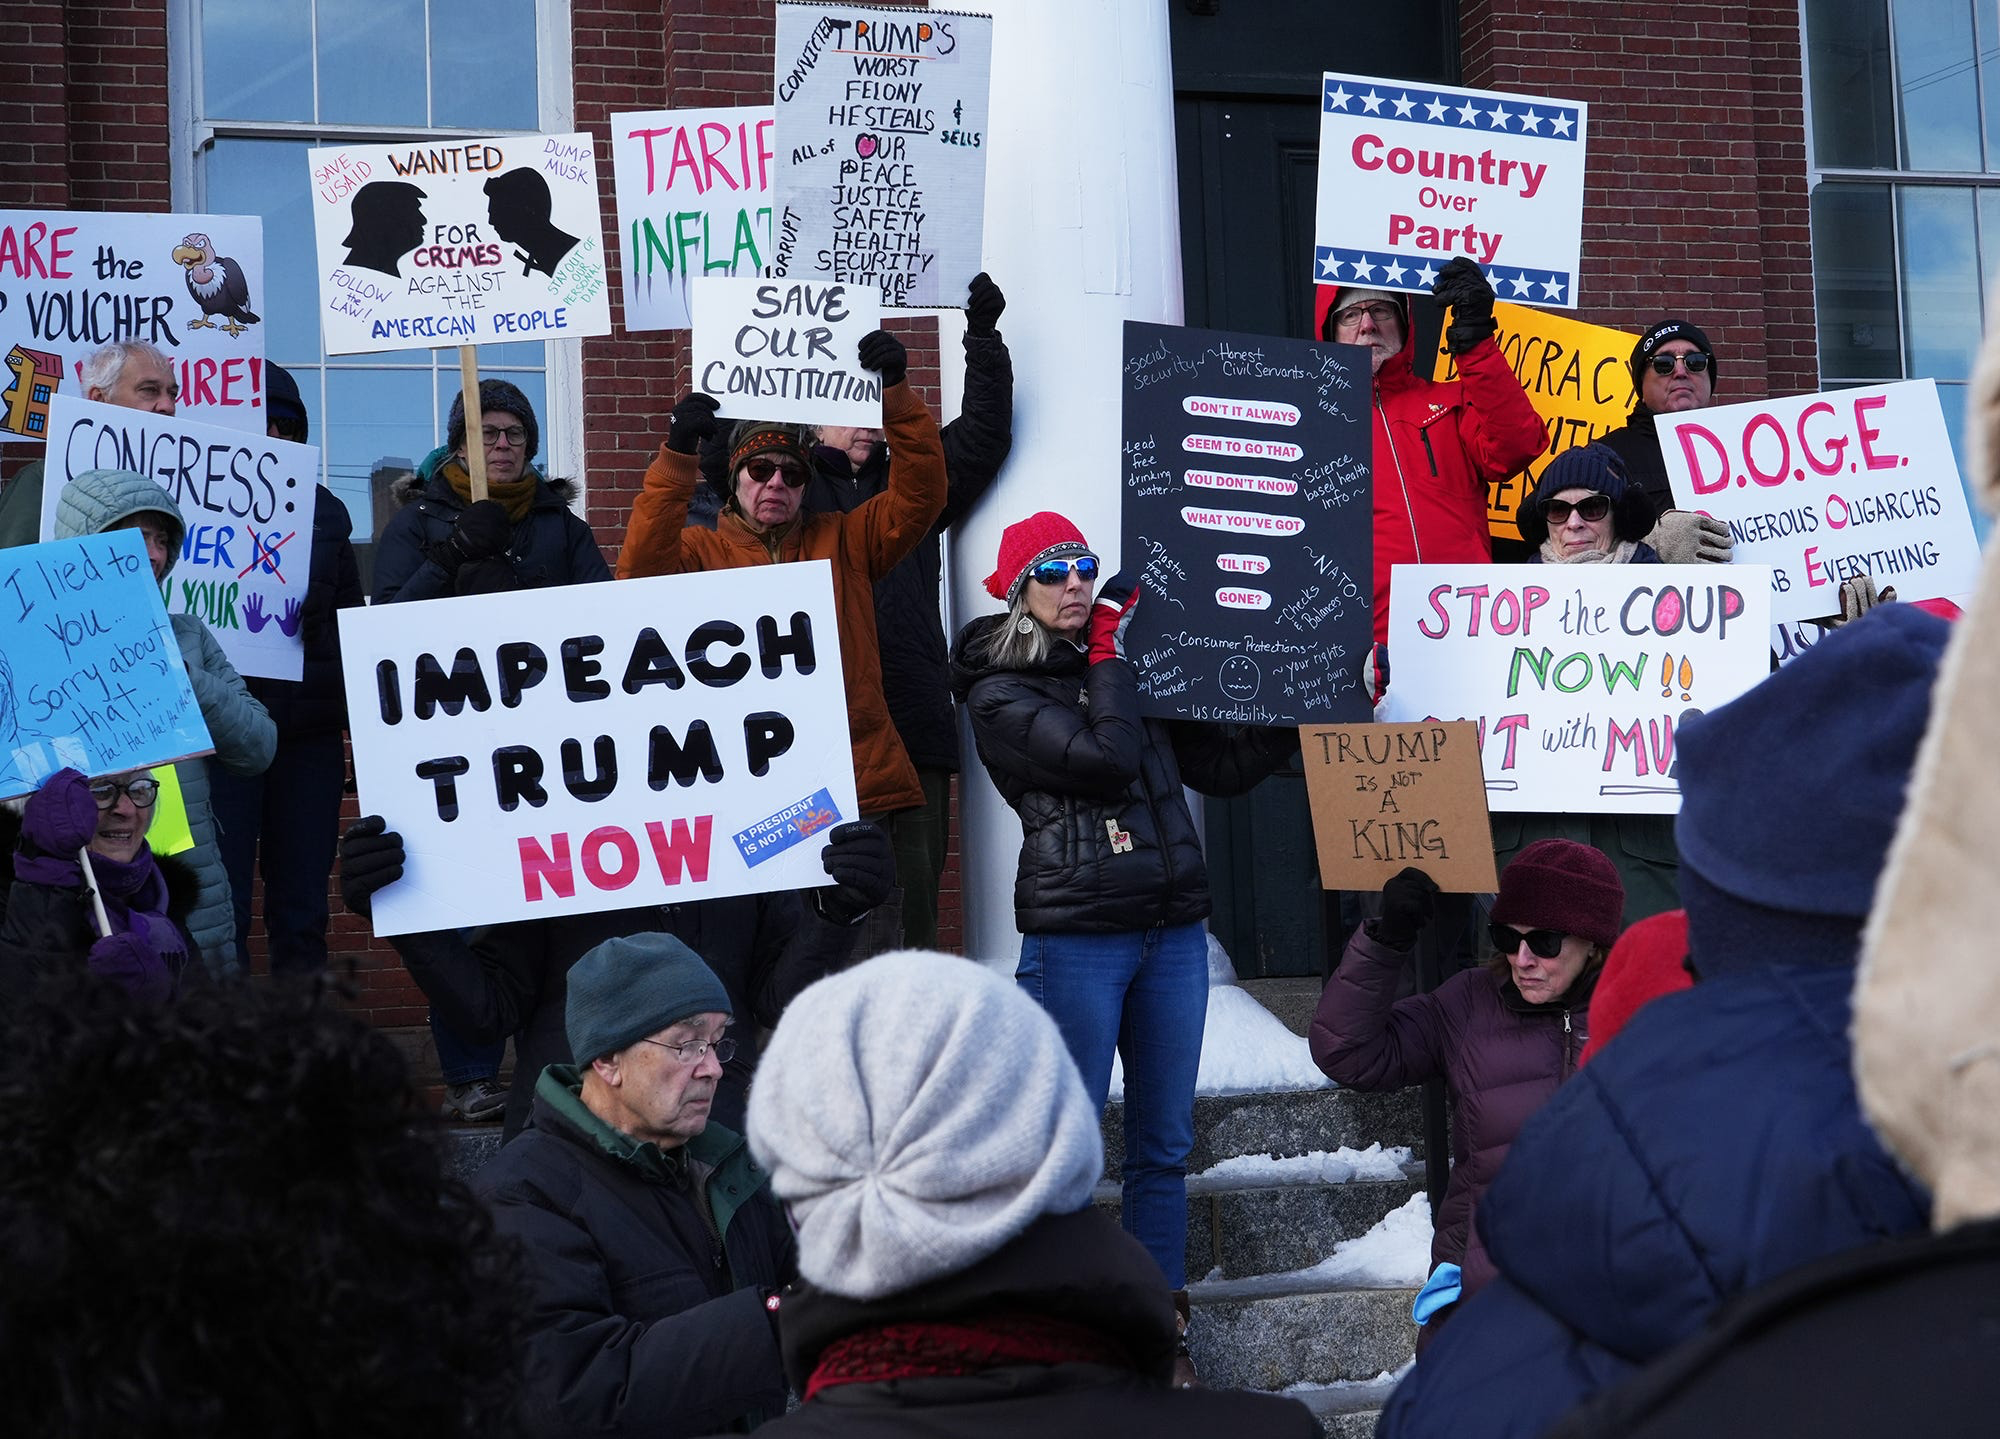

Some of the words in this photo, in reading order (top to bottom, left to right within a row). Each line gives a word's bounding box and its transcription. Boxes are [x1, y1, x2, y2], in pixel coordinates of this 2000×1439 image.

[831, 20, 956, 55] TRUMP'S
[854, 56, 919, 77] WORST
[846, 81, 922, 101] FELONY
[543, 138, 592, 162] DUMP
[855, 133, 905, 160] OUR
[940, 130, 981, 147] SELLS
[314, 153, 352, 185] SAVE
[387, 144, 504, 176] WANTED
[544, 159, 589, 185] MUSK
[839, 159, 916, 187] PEACE
[1351, 133, 1548, 198] Country
[320, 160, 372, 205] USAID
[830, 185, 923, 210] JUSTICE
[1419, 187, 1478, 213] Over
[435, 224, 481, 245] FOR
[833, 207, 926, 231] SAFETY
[833, 231, 920, 253] HEALTH
[1388, 214, 1503, 264] Party
[92, 245, 144, 281] the
[413, 243, 502, 269] CRIMES
[547, 269, 568, 296] STAY
[564, 249, 585, 273] OUT
[583, 236, 596, 252] OF
[571, 262, 590, 282] OUR
[814, 250, 934, 272] SECURITY
[329, 268, 393, 303] FOLLOW
[408, 270, 506, 296] AGAINST
[562, 263, 603, 306] PERSONAL
[580, 278, 605, 304] DATA
[26, 288, 181, 347] VOUCHER
[442, 293, 486, 310] THE
[751, 284, 850, 323] SAVE
[371, 315, 476, 339] AMERICAN
[494, 307, 568, 334] PEOPLE
[735, 324, 837, 361] OUR
[701, 360, 881, 403] CONSTITUTION
[1190, 400, 1228, 416] DON'T
[1232, 405, 1243, 417] IT
[1245, 407, 1297, 423] ALWAYS
[1186, 437, 1222, 451] SEEM
[1225, 441, 1241, 453] TO
[1245, 443, 1263, 455] GO
[1266, 445, 1297, 458] THAT
[1674, 395, 1909, 494] D.O.G.E.
[65, 418, 297, 524] CONGRESS:
[1128, 470, 1172, 487] drinking
[1187, 473, 1213, 486] YOU
[1216, 475, 1254, 490] DON'T
[1257, 480, 1297, 494] KNOW
[1303, 475, 1335, 502] based
[1336, 463, 1370, 486] health
[1137, 483, 1169, 497] water
[1186, 511, 1223, 526] WHAT
[1226, 515, 1273, 530] YOU'VE
[1275, 519, 1301, 532] GOT
[1693, 506, 1819, 545] NGEROUS
[1825, 486, 1942, 530] OLIGARCHS
[36, 543, 104, 601] lied
[107, 545, 140, 578] to
[1242, 560, 1265, 573] IT'S
[1313, 554, 1357, 598] NATO
[1804, 541, 1941, 588] EVERYTHING
[1140, 574, 1167, 600] earth
[1218, 591, 1263, 605] GONE?
[182, 577, 240, 631] YOUR
[1417, 584, 1551, 640] STOP
[1559, 589, 1610, 636] the
[1619, 585, 1745, 641] COUP
[109, 617, 169, 674] about
[1178, 631, 1241, 651] Consumer
[1313, 643, 1346, 670] rights
[375, 611, 817, 726] IMPEACH
[1298, 677, 1321, 698] your
[1327, 667, 1349, 682] own
[1313, 728, 1448, 766] TRUMP
[1542, 713, 1598, 752] with
[415, 711, 795, 822] TRUMP
[1354, 774, 1378, 792] IS
[1389, 770, 1423, 790] NOT
[1378, 789, 1400, 814] A
[738, 833, 748, 844] A
[750, 796, 815, 838] PRESIDENT
[743, 842, 758, 856] IS
[758, 829, 784, 848] NOT
[787, 823, 797, 835] A
[1348, 818, 1450, 862] KING
[517, 815, 713, 903] NOW
